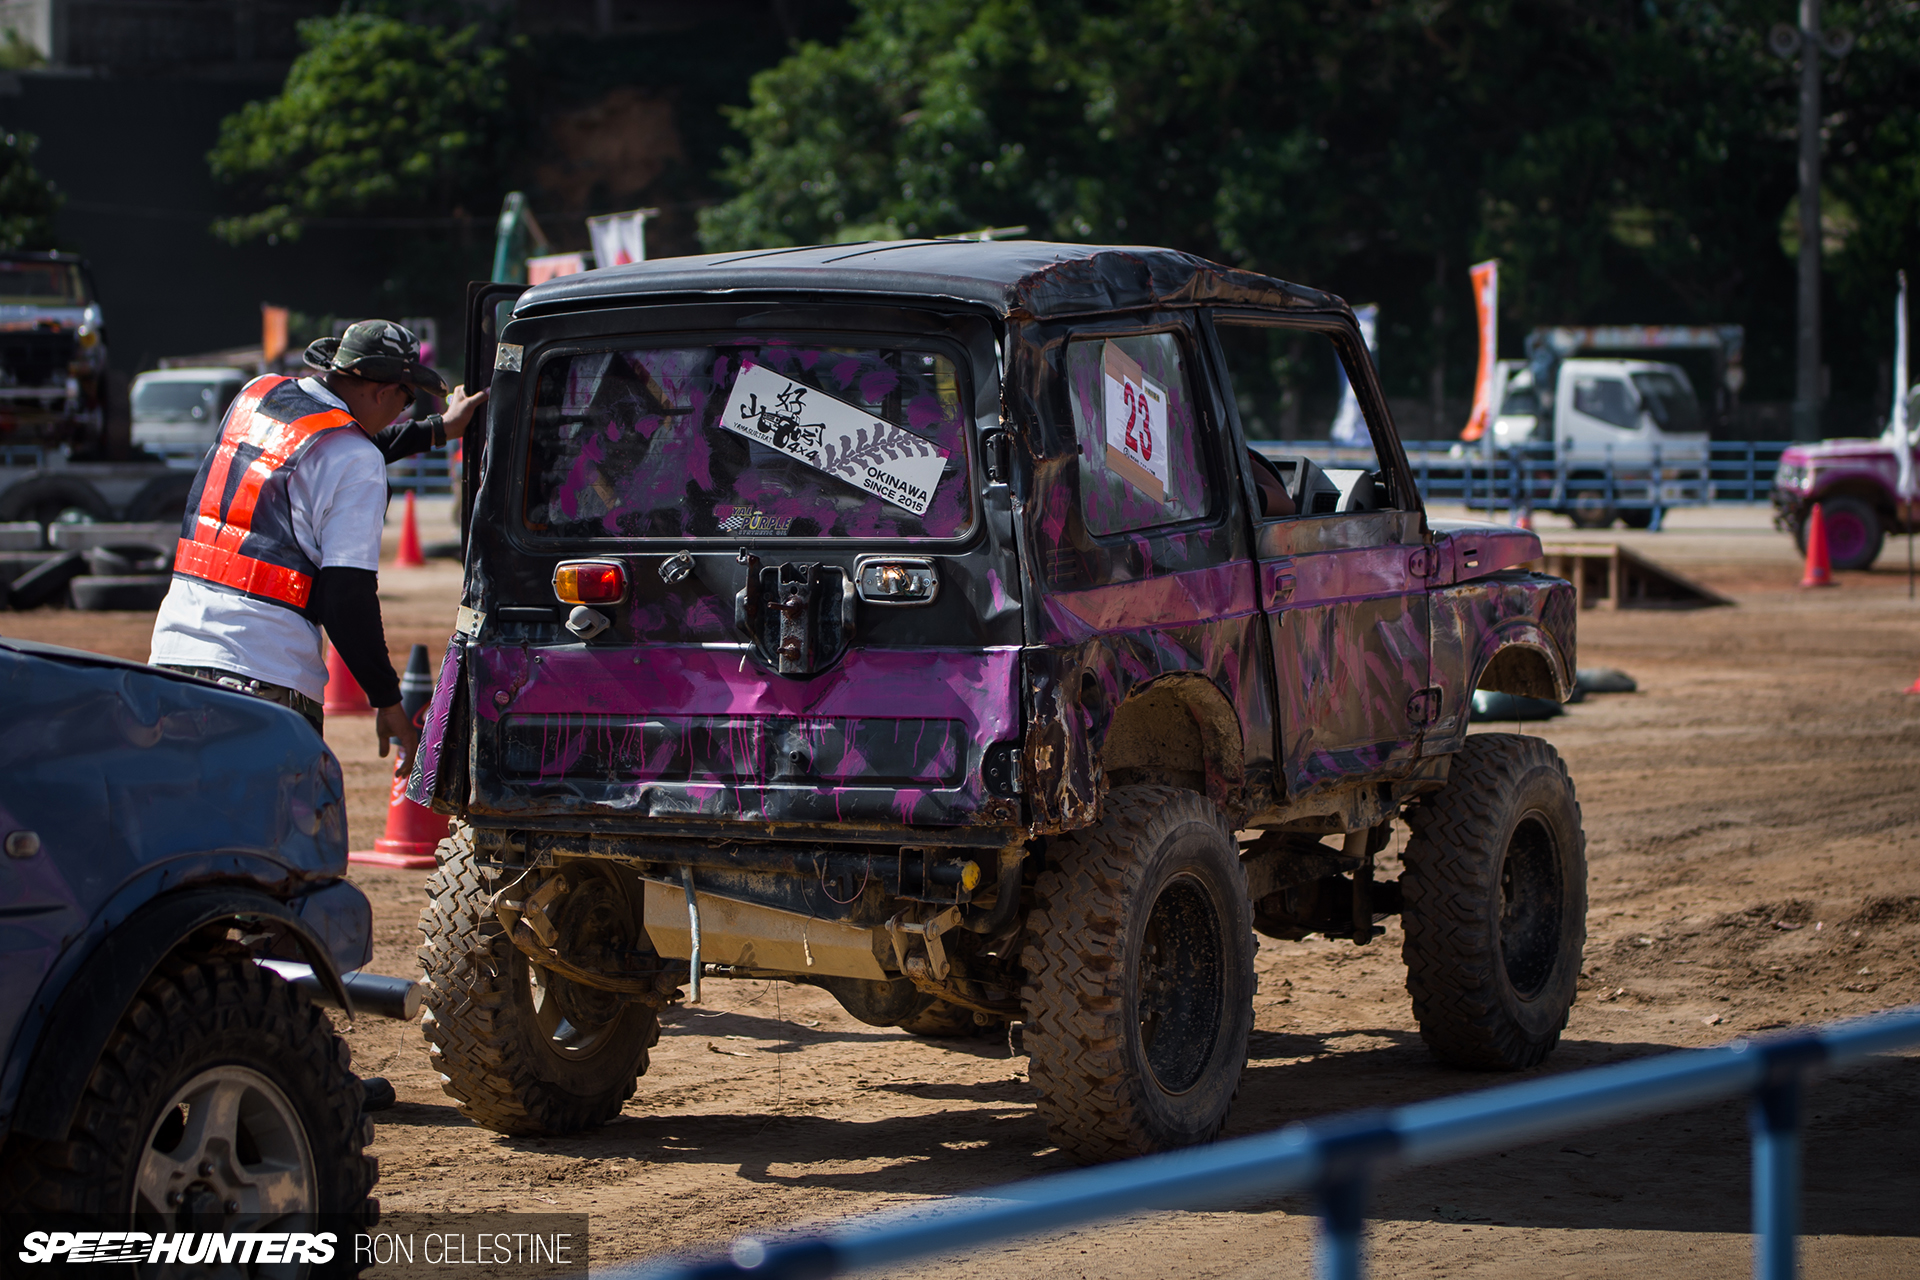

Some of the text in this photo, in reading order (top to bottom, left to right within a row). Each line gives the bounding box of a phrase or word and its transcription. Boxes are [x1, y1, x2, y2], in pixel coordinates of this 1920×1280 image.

[1124, 382, 1152, 461] 23
[863, 479, 924, 512] SINCE 2015
[867, 466, 927, 502] OKINAWA
[714, 507, 752, 516] YAL
[741, 516, 792, 530] PURPLE
